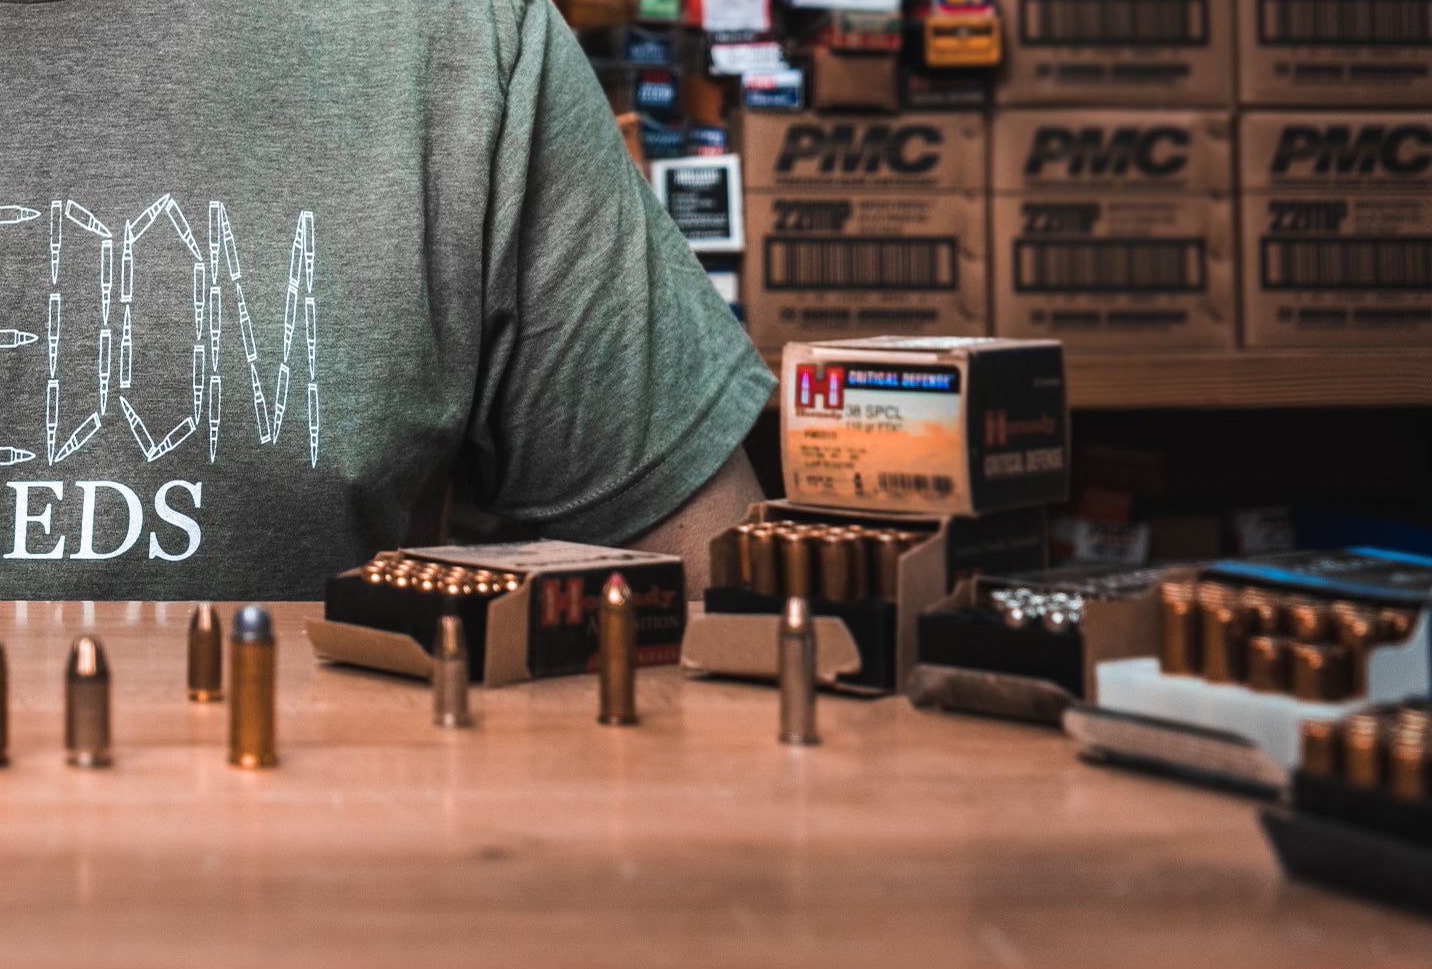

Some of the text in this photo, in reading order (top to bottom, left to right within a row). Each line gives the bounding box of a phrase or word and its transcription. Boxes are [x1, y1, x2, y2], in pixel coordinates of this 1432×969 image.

[775, 124, 944, 173] PMC
[1023, 125, 1192, 176] PMC
[1271, 124, 1432, 175] PMC
[848, 369, 899, 387] CRITICAL
[845, 403, 903, 420] 38 SPCL
